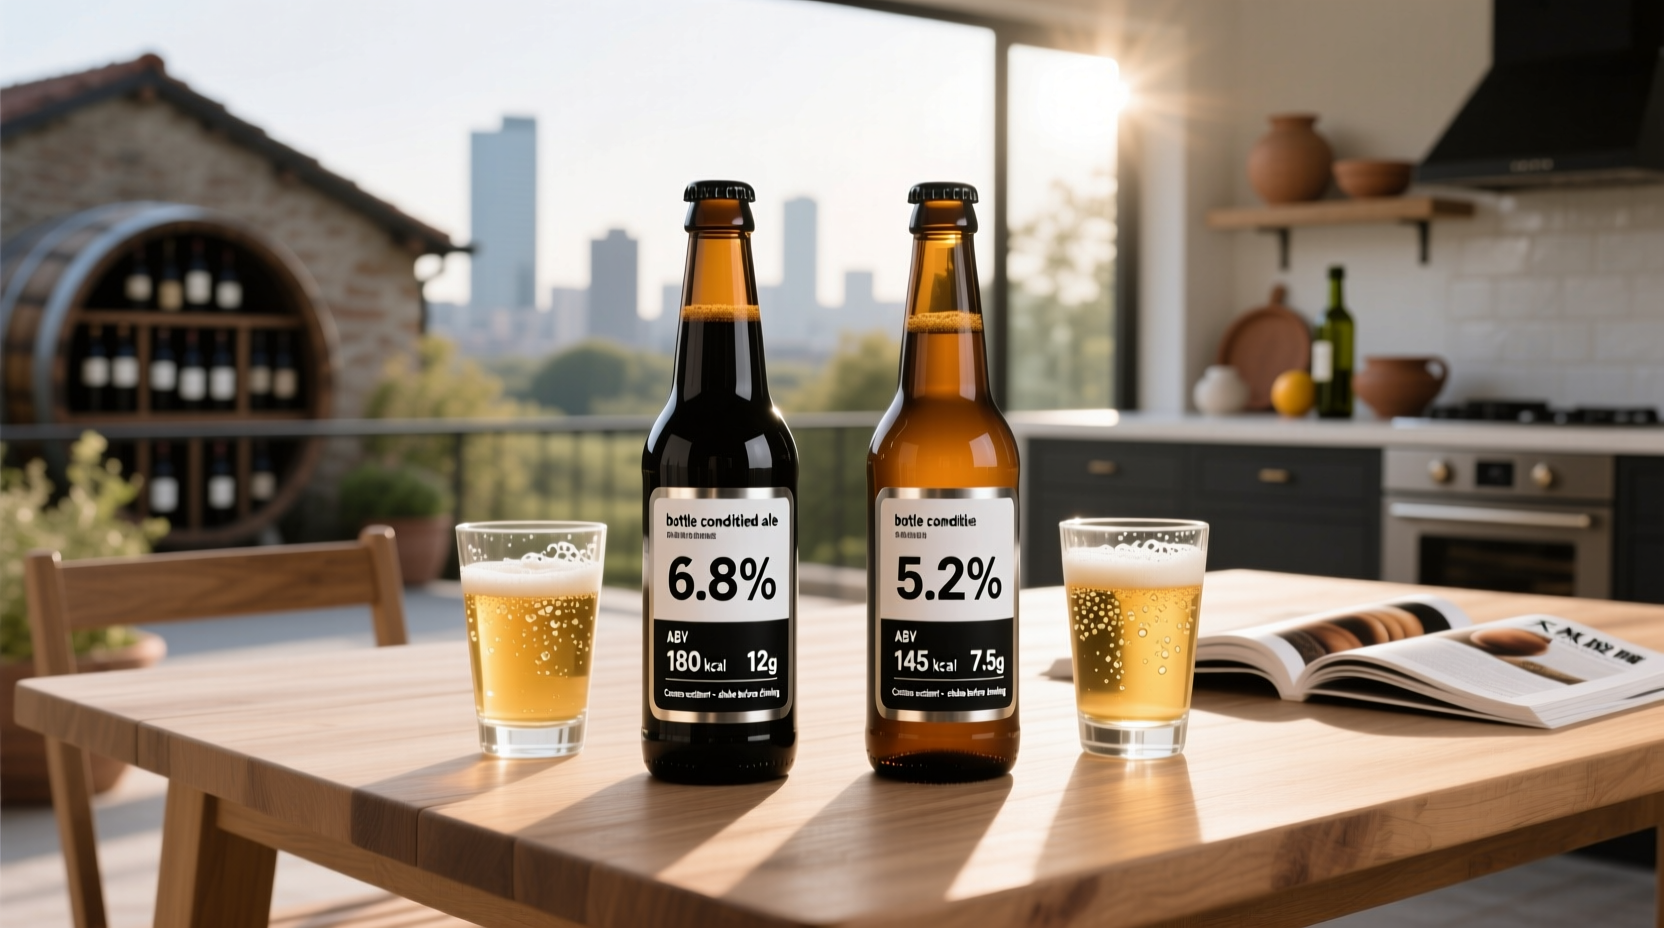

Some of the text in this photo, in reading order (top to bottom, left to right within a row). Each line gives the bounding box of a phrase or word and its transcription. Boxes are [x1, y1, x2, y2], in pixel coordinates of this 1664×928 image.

[666, 513, 697, 527] bottle
[761, 512, 779, 527] ale
[668, 555, 777, 602] 6.8%
[896, 555, 1002, 601] 5.2%
[666, 630, 689, 644] ABV
[894, 629, 917, 643] ABV
[666, 649, 778, 675] 180 kcal 12g
[894, 648, 1005, 674] 145 kcal 7.5g
